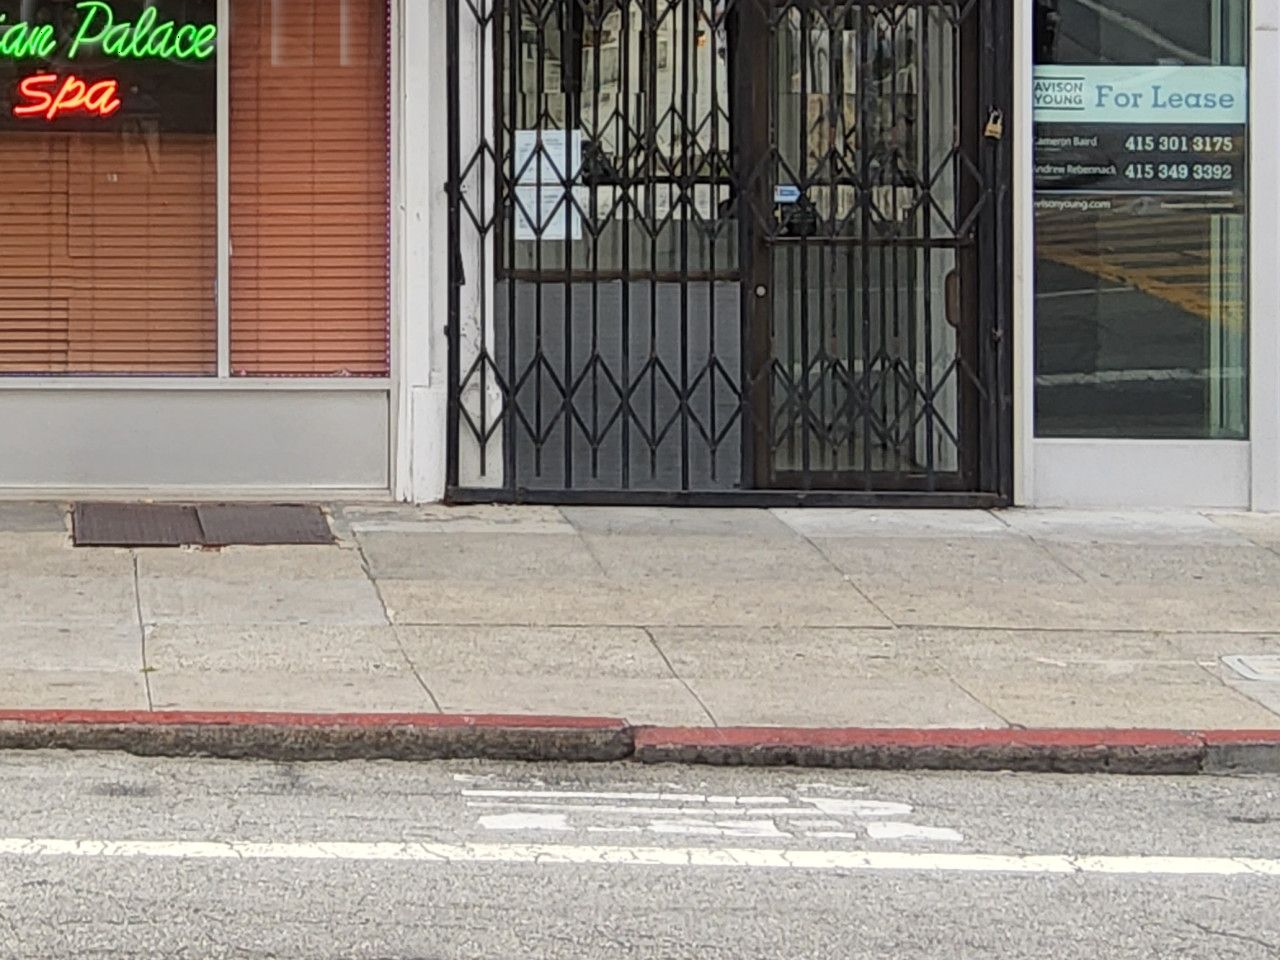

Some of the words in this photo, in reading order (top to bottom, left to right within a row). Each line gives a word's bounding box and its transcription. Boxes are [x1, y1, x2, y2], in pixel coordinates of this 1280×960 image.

[67, 0, 217, 59] Palace
[1035, 82, 1083, 92] AVISON
[13, 74, 120, 120] Spa
[1035, 94, 1083, 105] YOUNG
[1095, 85, 1143, 108] For
[1151, 85, 1235, 108] Lease
[1124, 136, 1155, 151] 415
[1159, 136, 1188, 151] 301
[1192, 136, 1233, 151] 3175
[1037, 164, 1065, 174] ndrew
[1124, 164, 1155, 179] 415
[1158, 164, 1188, 179] 349
[1192, 164, 1232, 179] 3392
[1035, 199, 1111, 211] visonyoung.com
